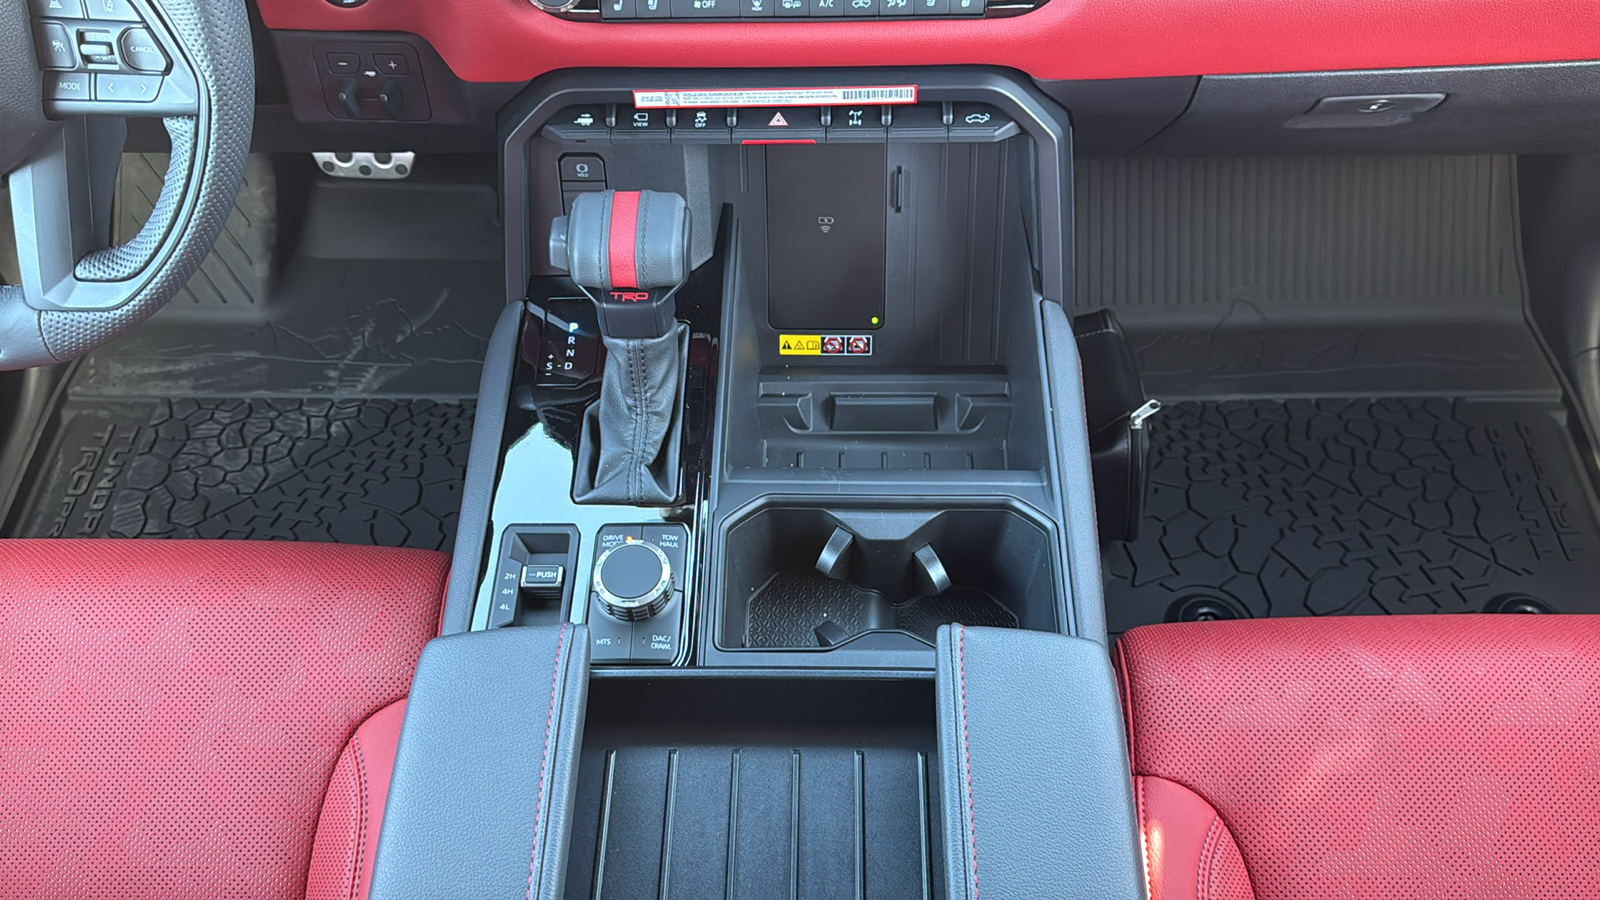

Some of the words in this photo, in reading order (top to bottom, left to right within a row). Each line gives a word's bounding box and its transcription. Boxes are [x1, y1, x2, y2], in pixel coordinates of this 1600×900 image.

[702, 0, 716, 9] OFF
[818, 0, 834, 8] A/C
[130, 46, 154, 54] CANCEL
[59, 82, 81, 91] MODE
[610, 292, 649, 302] TRD
[568, 322, 579, 332] P
[567, 336, 576, 345] R
[566, 349, 575, 357] N
[546, 362, 553, 371] S
[564, 362, 573, 371] D
[67, 423, 117, 497] TRD
[77, 425, 141, 538] TUNDR
[47, 495, 78, 538] PR
[504, 572, 516, 580] 2H
[536, 571, 557, 579] PUSH
[650, 642, 672, 650] CRAWL
